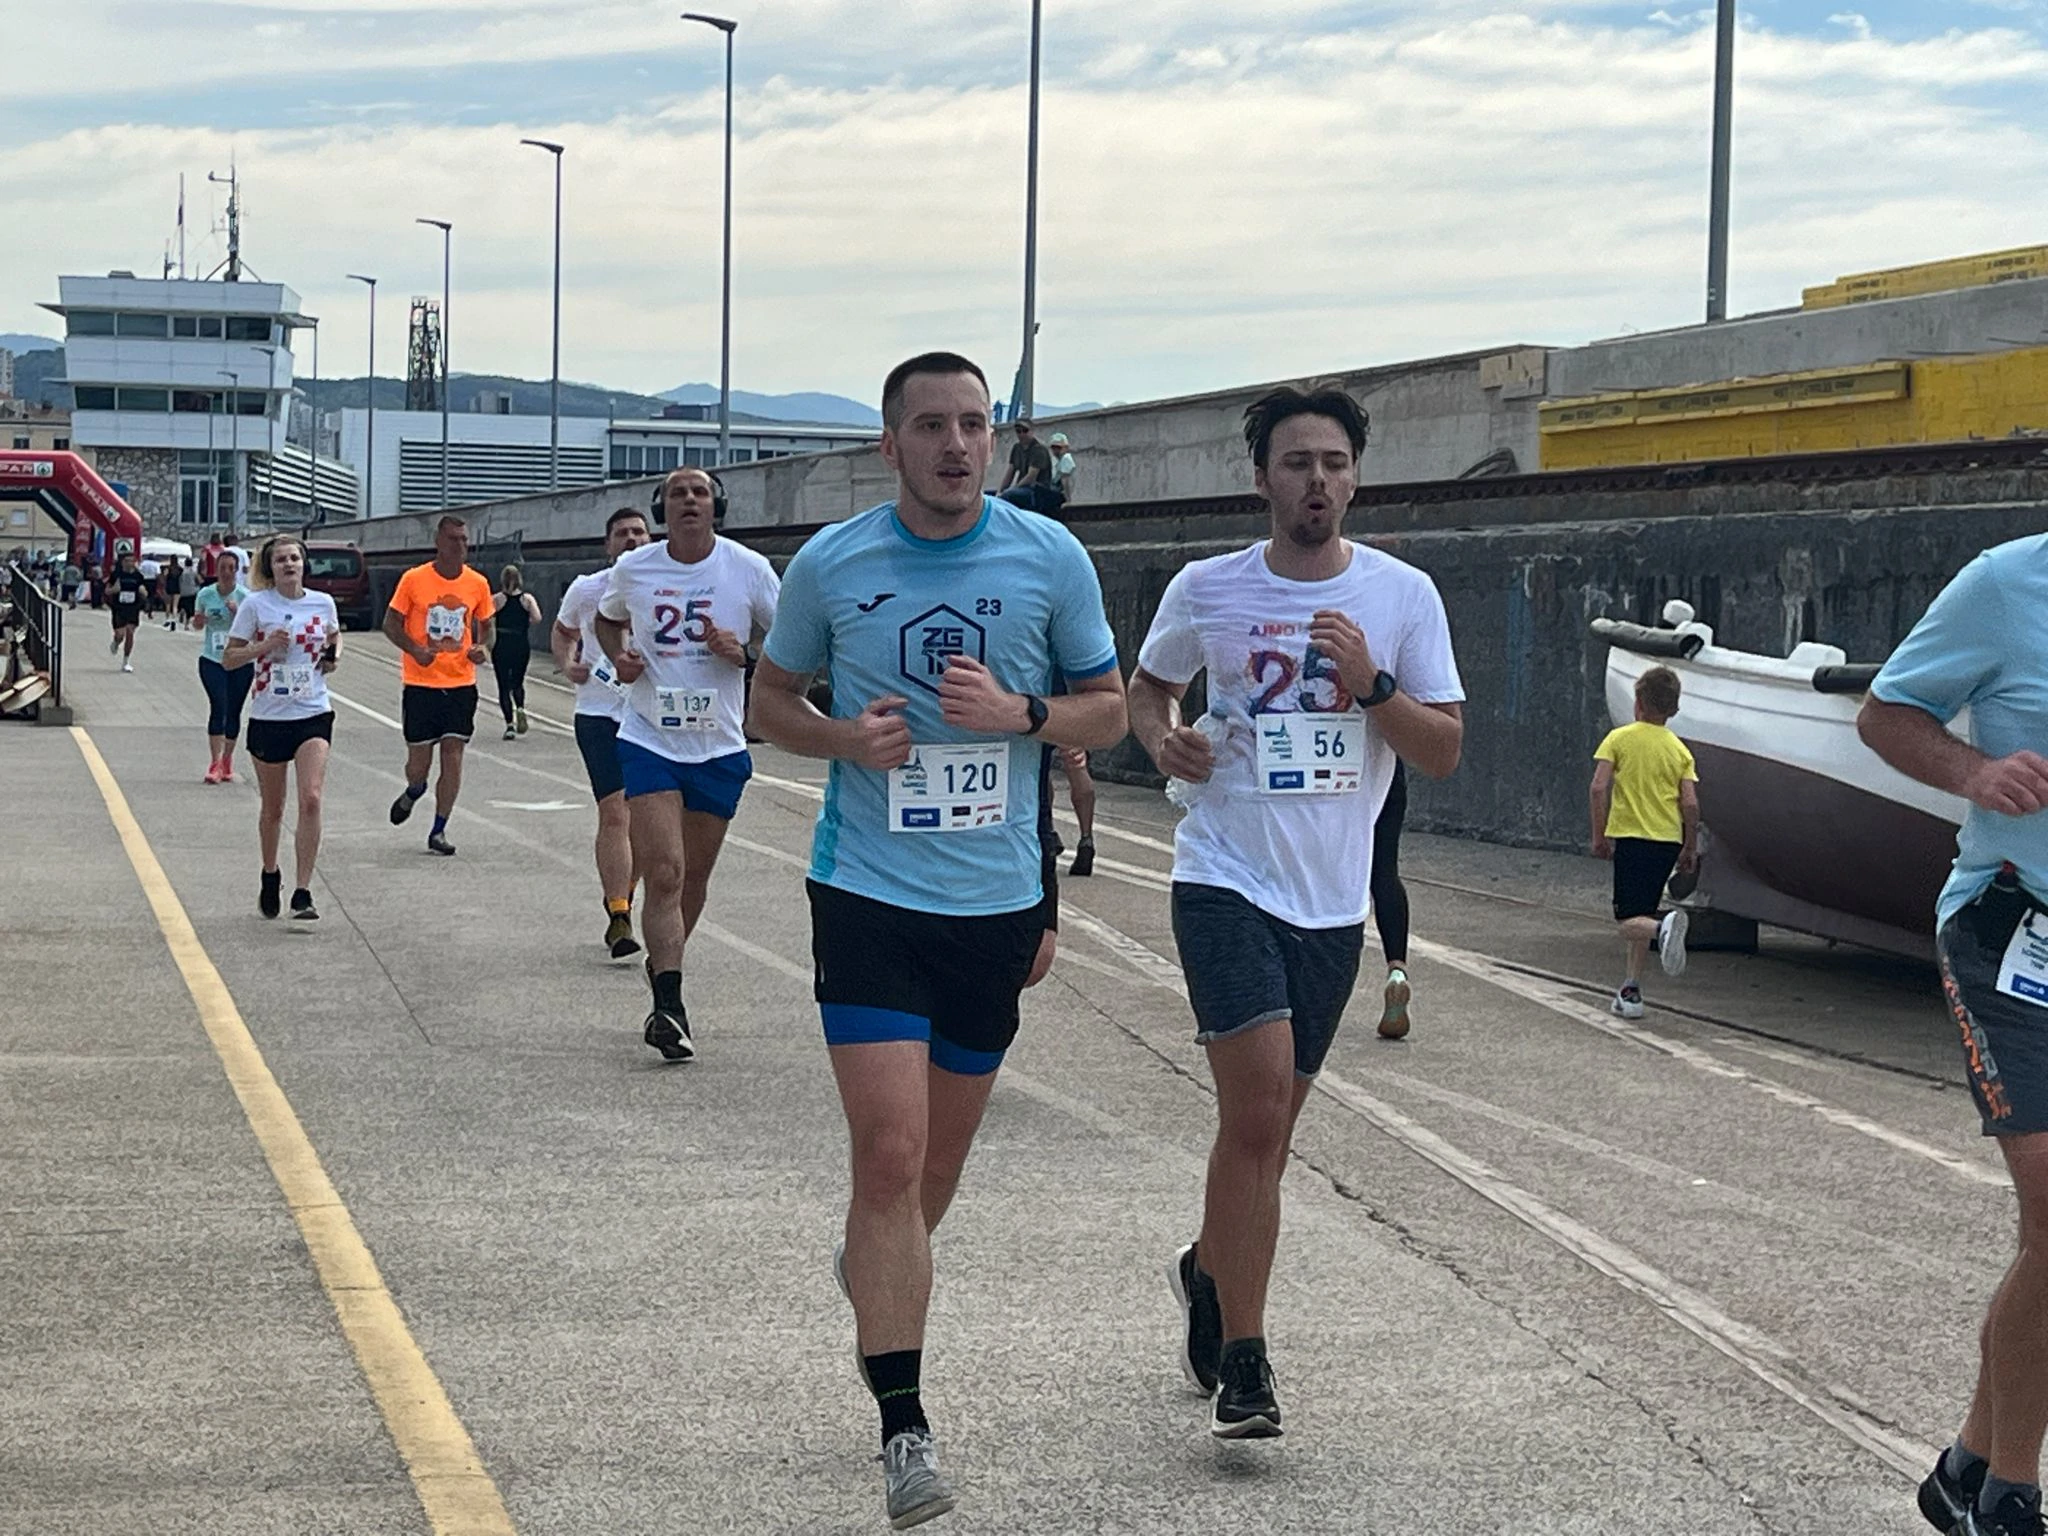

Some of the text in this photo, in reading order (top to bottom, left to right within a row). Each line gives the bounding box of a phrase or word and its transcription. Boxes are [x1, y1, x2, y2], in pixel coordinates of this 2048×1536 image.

[975, 598, 1002, 616] 23
[655, 599, 713, 645] 25
[922, 627, 964, 647] ZG
[1249, 642, 1353, 717] 25
[683, 696, 710, 711] 137
[1314, 730, 1345, 758] 56
[943, 762, 997, 794] 120
